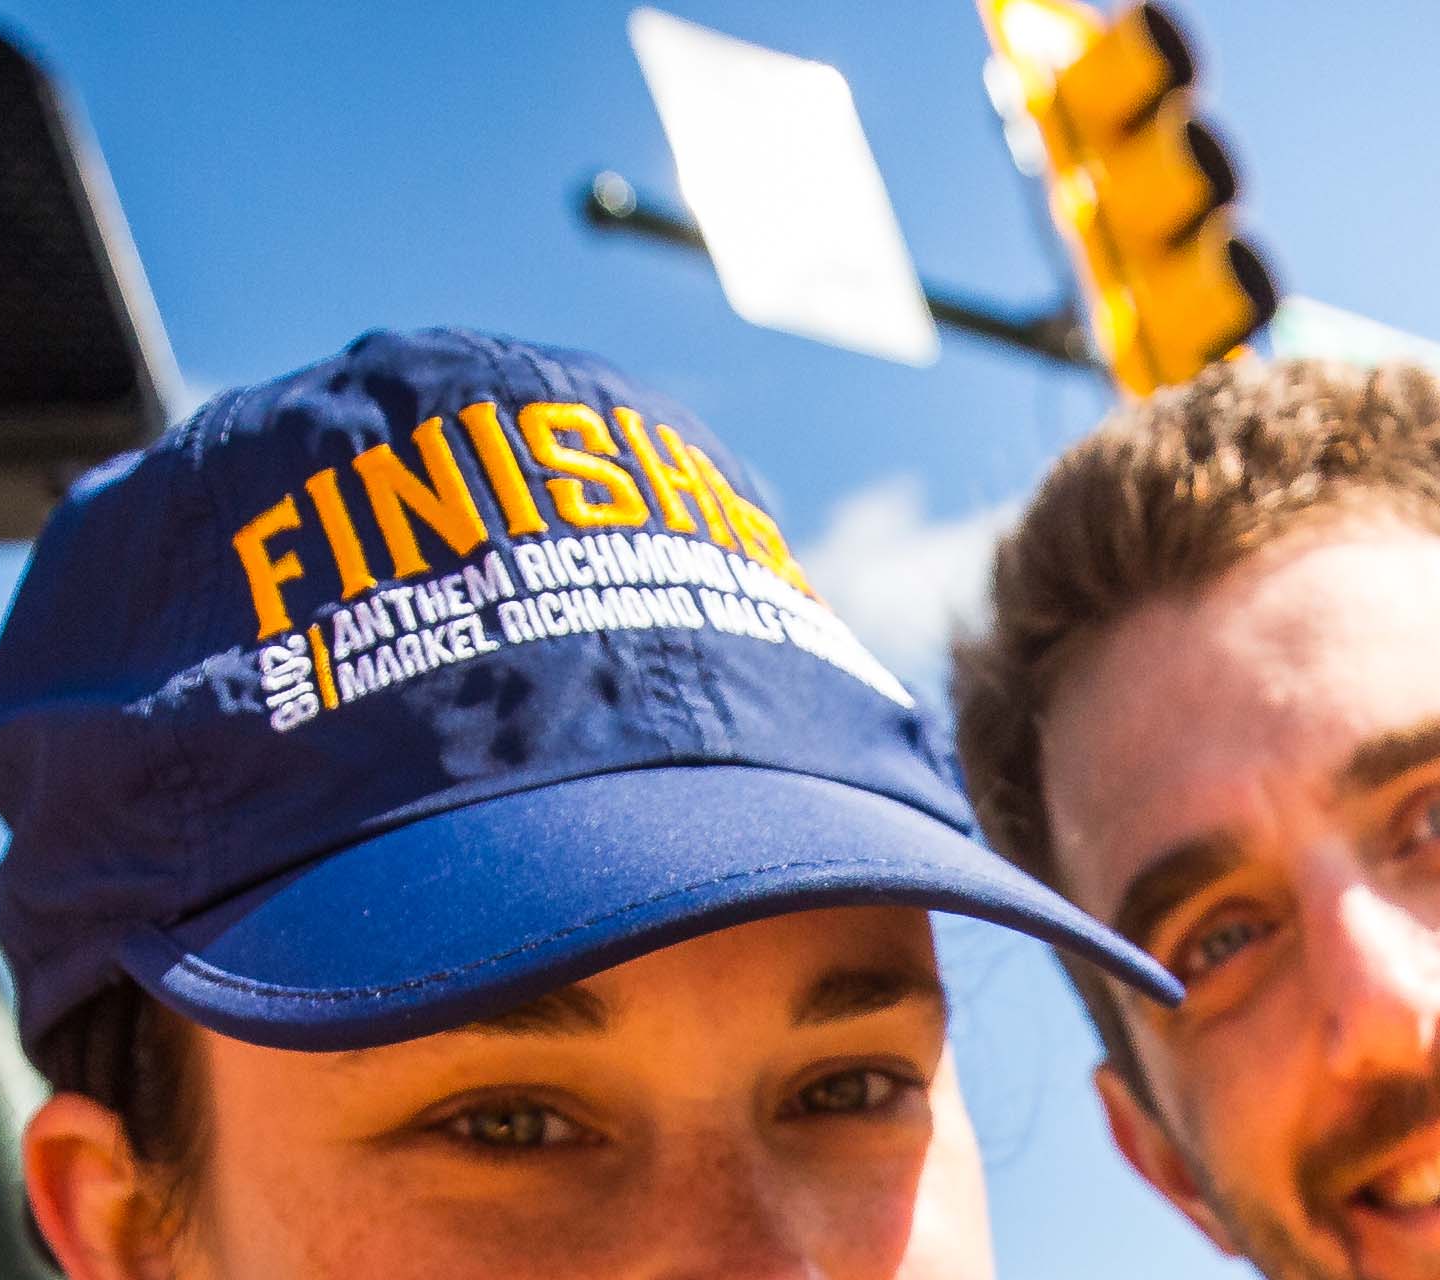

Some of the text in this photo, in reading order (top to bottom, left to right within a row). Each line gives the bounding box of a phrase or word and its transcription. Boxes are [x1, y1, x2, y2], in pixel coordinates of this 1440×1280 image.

[233, 401, 832, 641] FINISH
[333, 549, 516, 661] ANTHEM
[517, 532, 740, 597] RICHMOND
[336, 614, 500, 702] MARKEL
[500, 585, 705, 645] RICHMOND
[260, 634, 319, 733] 2018
